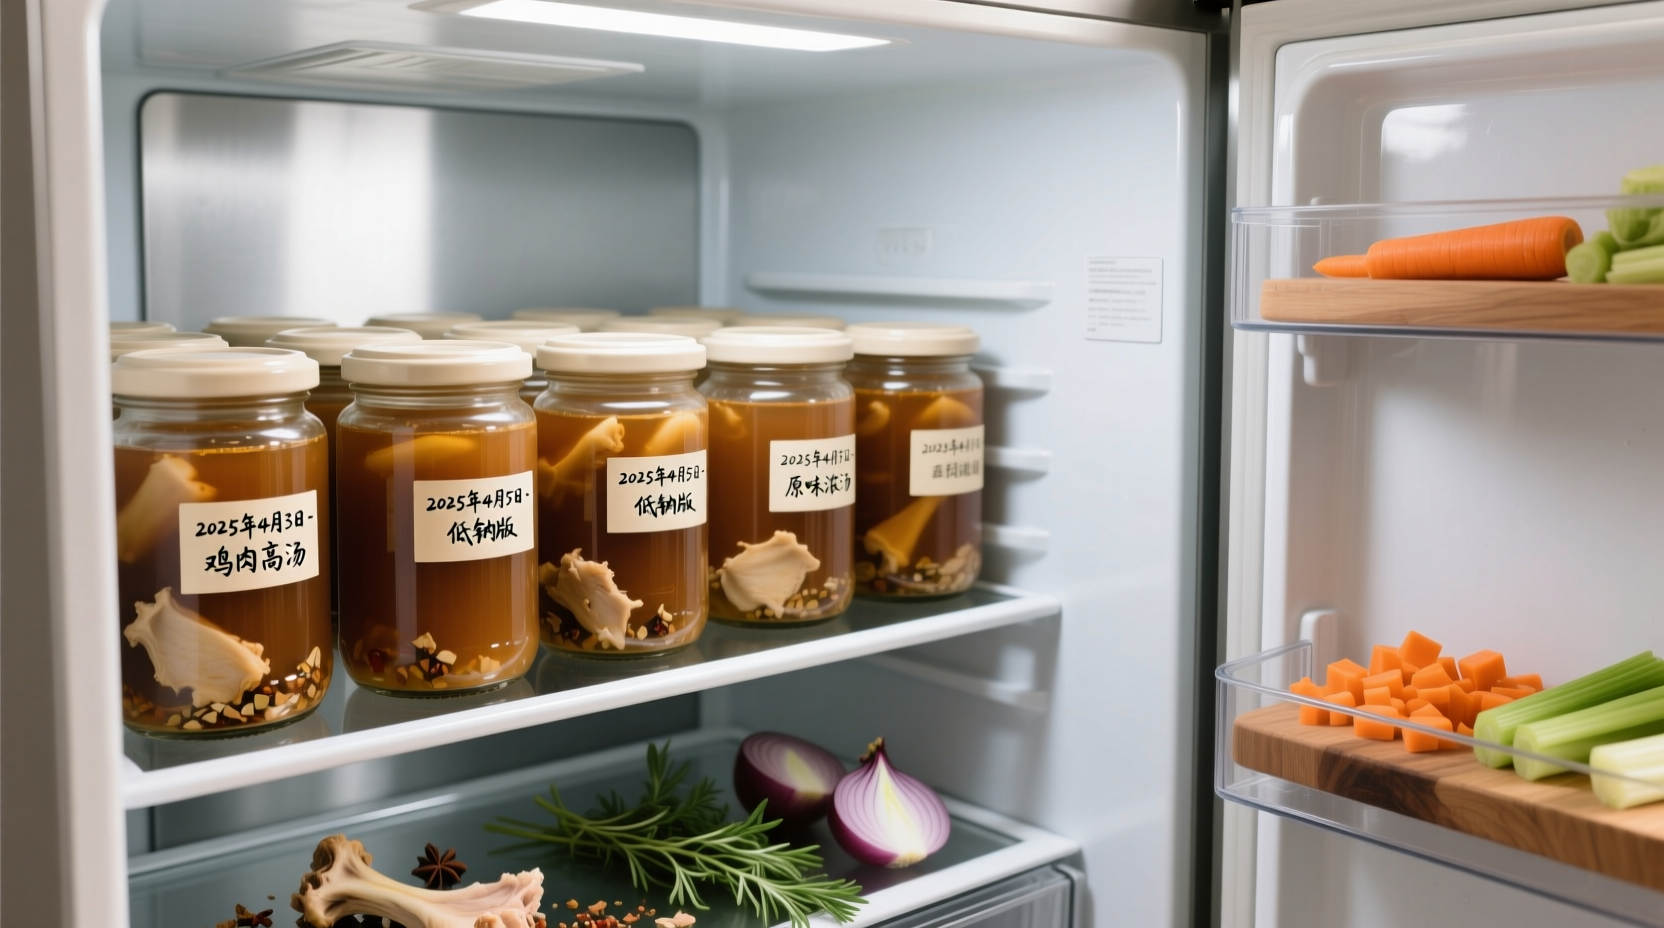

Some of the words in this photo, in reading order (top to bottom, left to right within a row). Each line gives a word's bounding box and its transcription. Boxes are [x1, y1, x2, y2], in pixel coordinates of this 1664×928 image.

[634, 492, 696, 518] 低钠版
[446, 516, 518, 546] 低钠版
[204, 541, 306, 577] 鸡肉高汤
